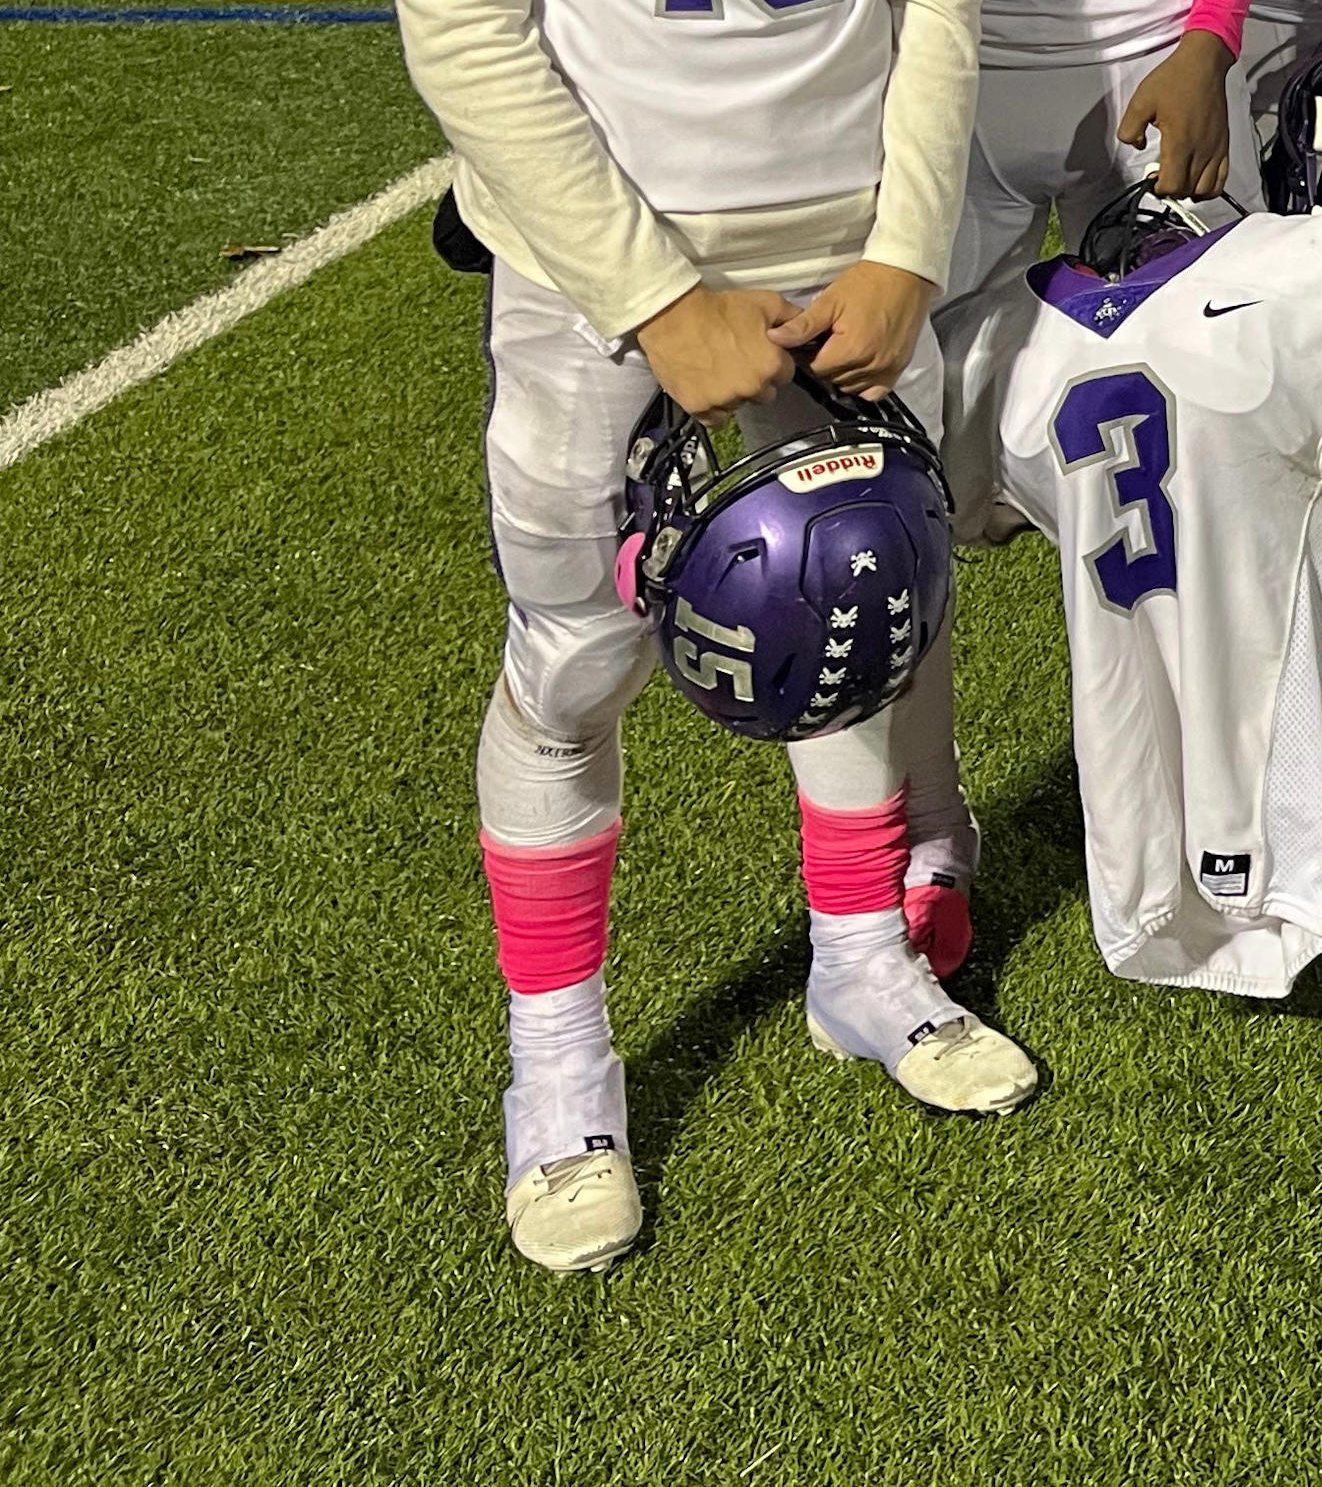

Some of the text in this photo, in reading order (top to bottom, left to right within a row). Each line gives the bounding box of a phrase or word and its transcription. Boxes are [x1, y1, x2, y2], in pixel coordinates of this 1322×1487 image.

[797, 454, 877, 482] Riddell
[1047, 362, 1178, 619] 3
[672, 596, 757, 703] 15
[1214, 858, 1235, 873] M
